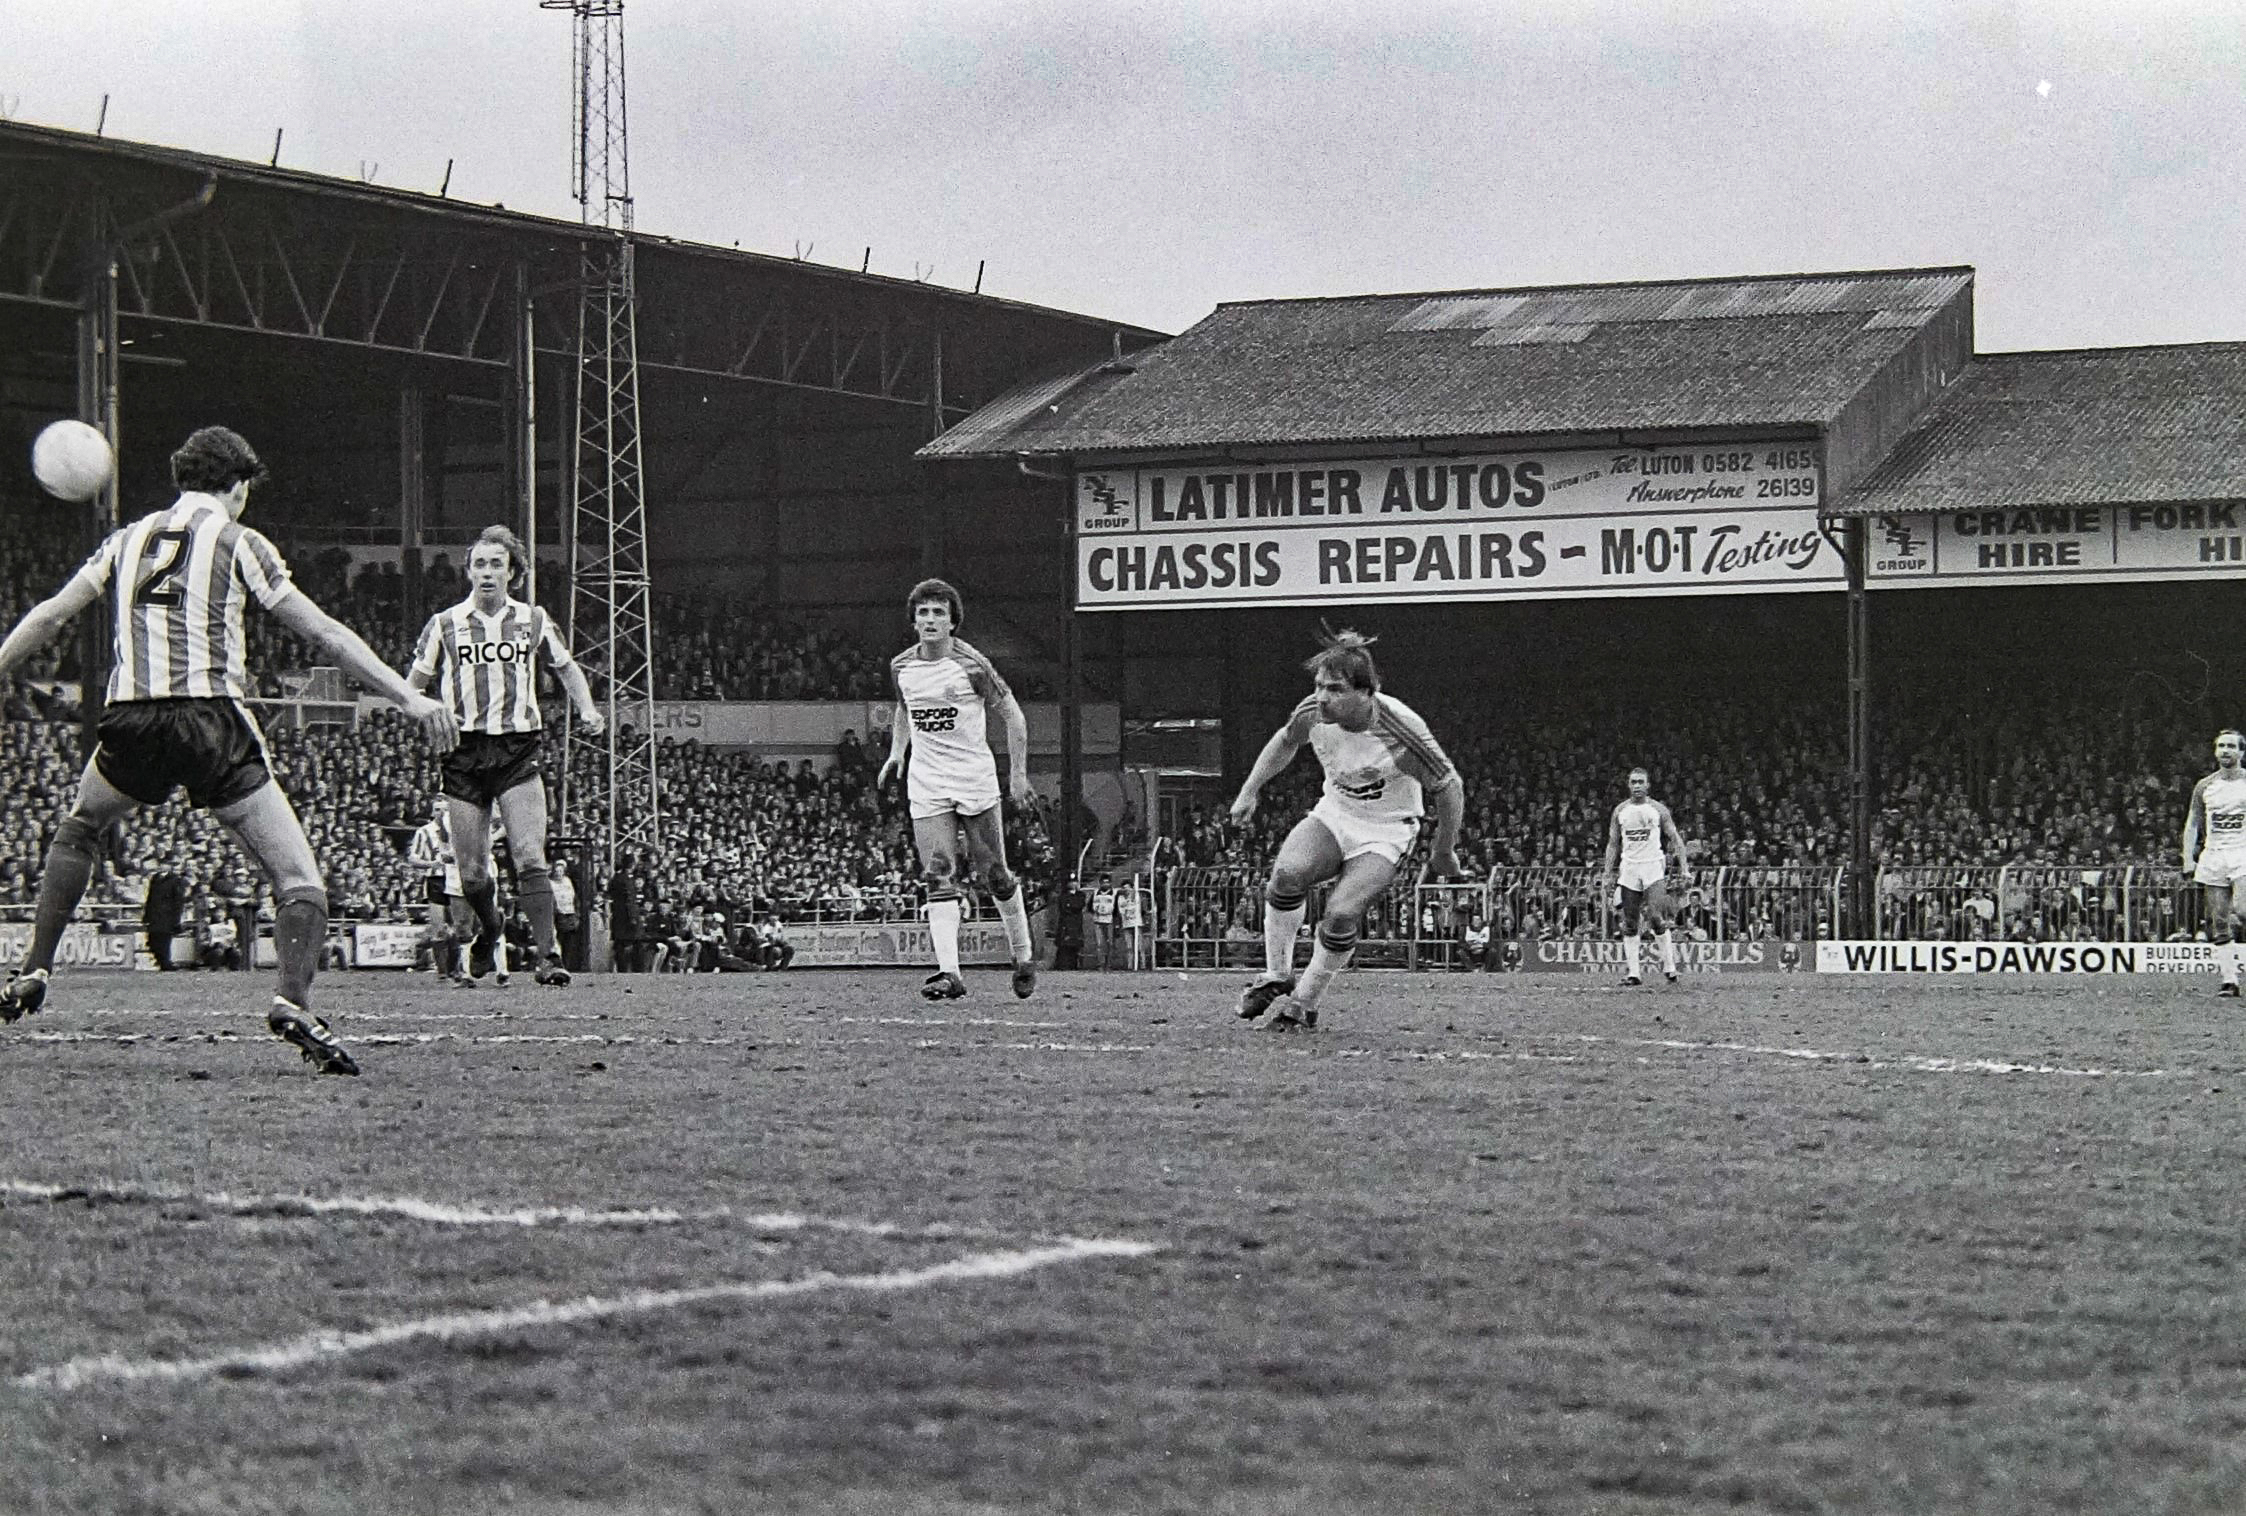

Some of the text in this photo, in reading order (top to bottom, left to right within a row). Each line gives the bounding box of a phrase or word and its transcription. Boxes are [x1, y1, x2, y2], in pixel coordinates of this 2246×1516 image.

[1641, 453, 1695, 475] LUTON
[1702, 452, 1755, 473] 0582
[1150, 462, 1547, 522] LATIMER AUTOS
[1626, 477, 1815, 503] Answerphone 26139
[1084, 517, 1130, 529] GROUP
[1953, 507, 2101, 537] CRANE
[2128, 502, 2238, 531] FORK
[1087, 540, 1281, 592] CHASSIS
[1318, 530, 1547, 585] REPAIRS
[1702, 524, 1822, 575] Testing
[1876, 559, 1927, 571] GROUP
[1978, 541, 2081, 568] HIRE
[136, 530, 191, 607] 2
[458, 641, 530, 666] RICOH
[1844, 945, 2136, 973] WILLIS-DAWSON
[2146, 946, 2217, 960] BUILDER
